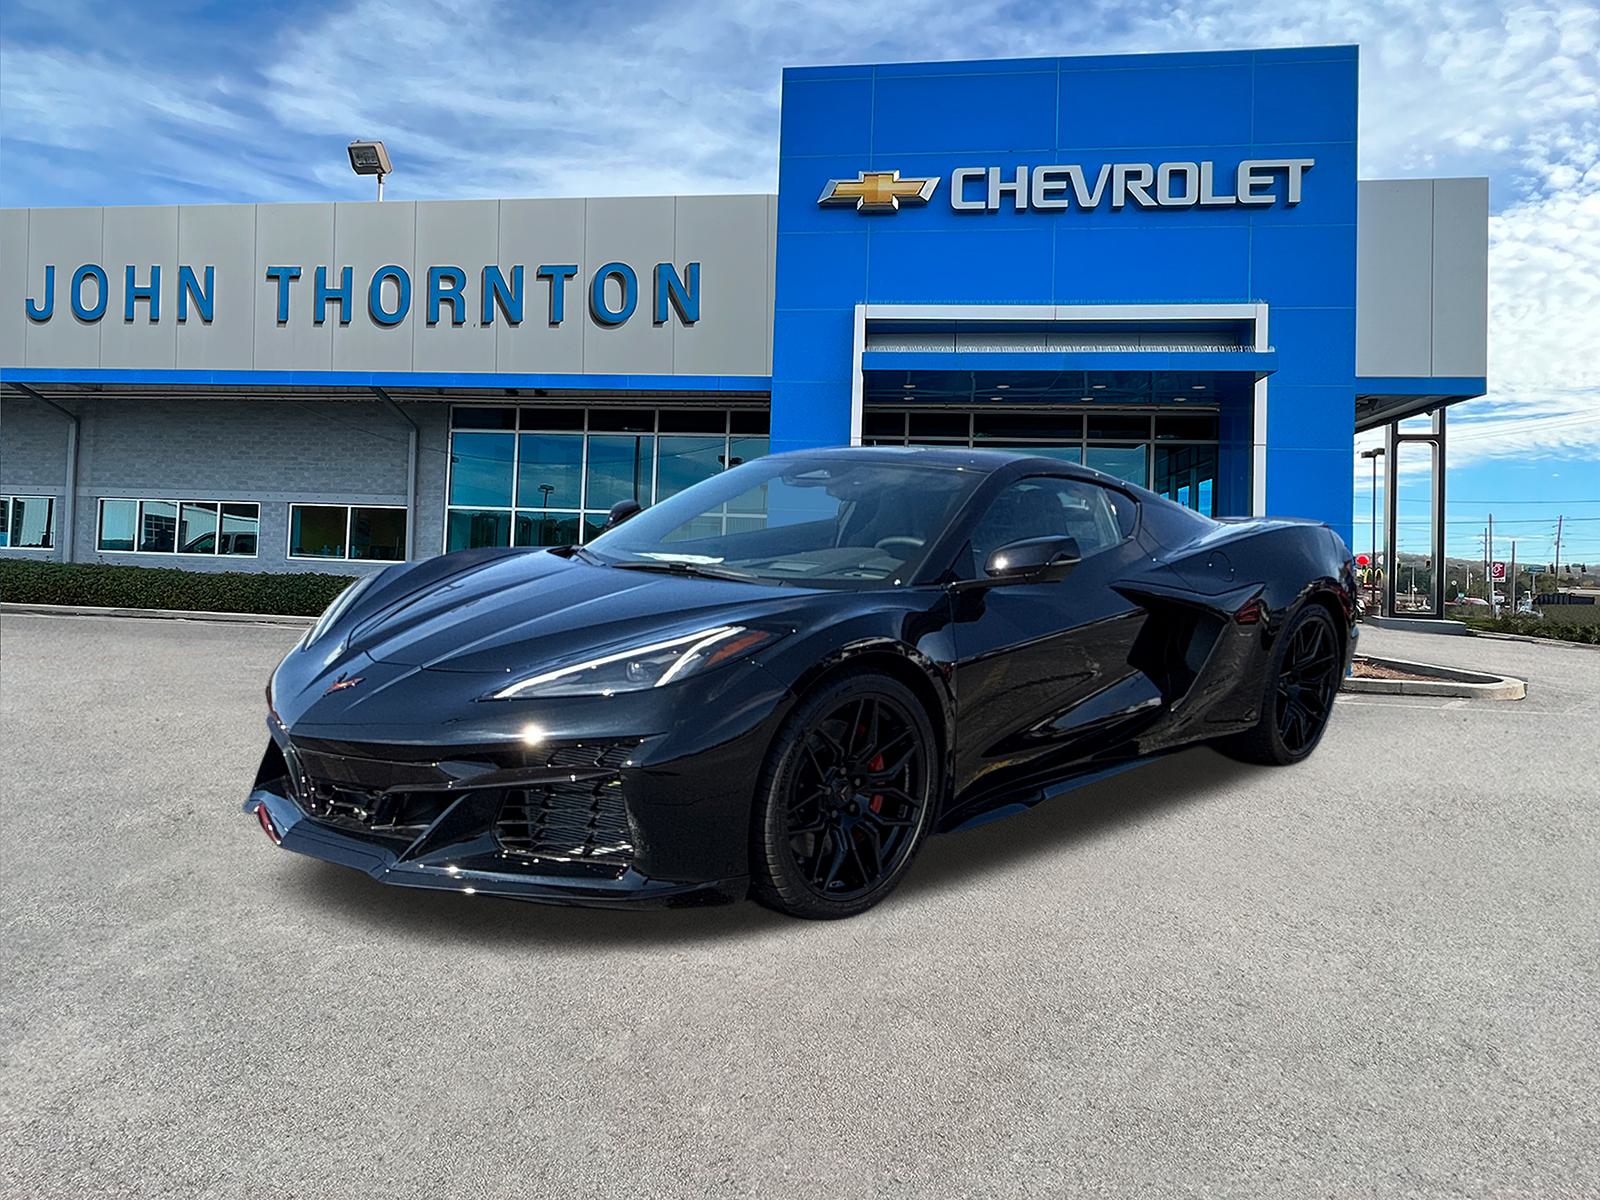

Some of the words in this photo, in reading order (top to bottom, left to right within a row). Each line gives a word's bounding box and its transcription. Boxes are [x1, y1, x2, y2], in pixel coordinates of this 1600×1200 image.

[950, 158, 1316, 212] CHEVROLET
[25, 263, 217, 324] JOHN
[266, 261, 702, 327] THORNTON
